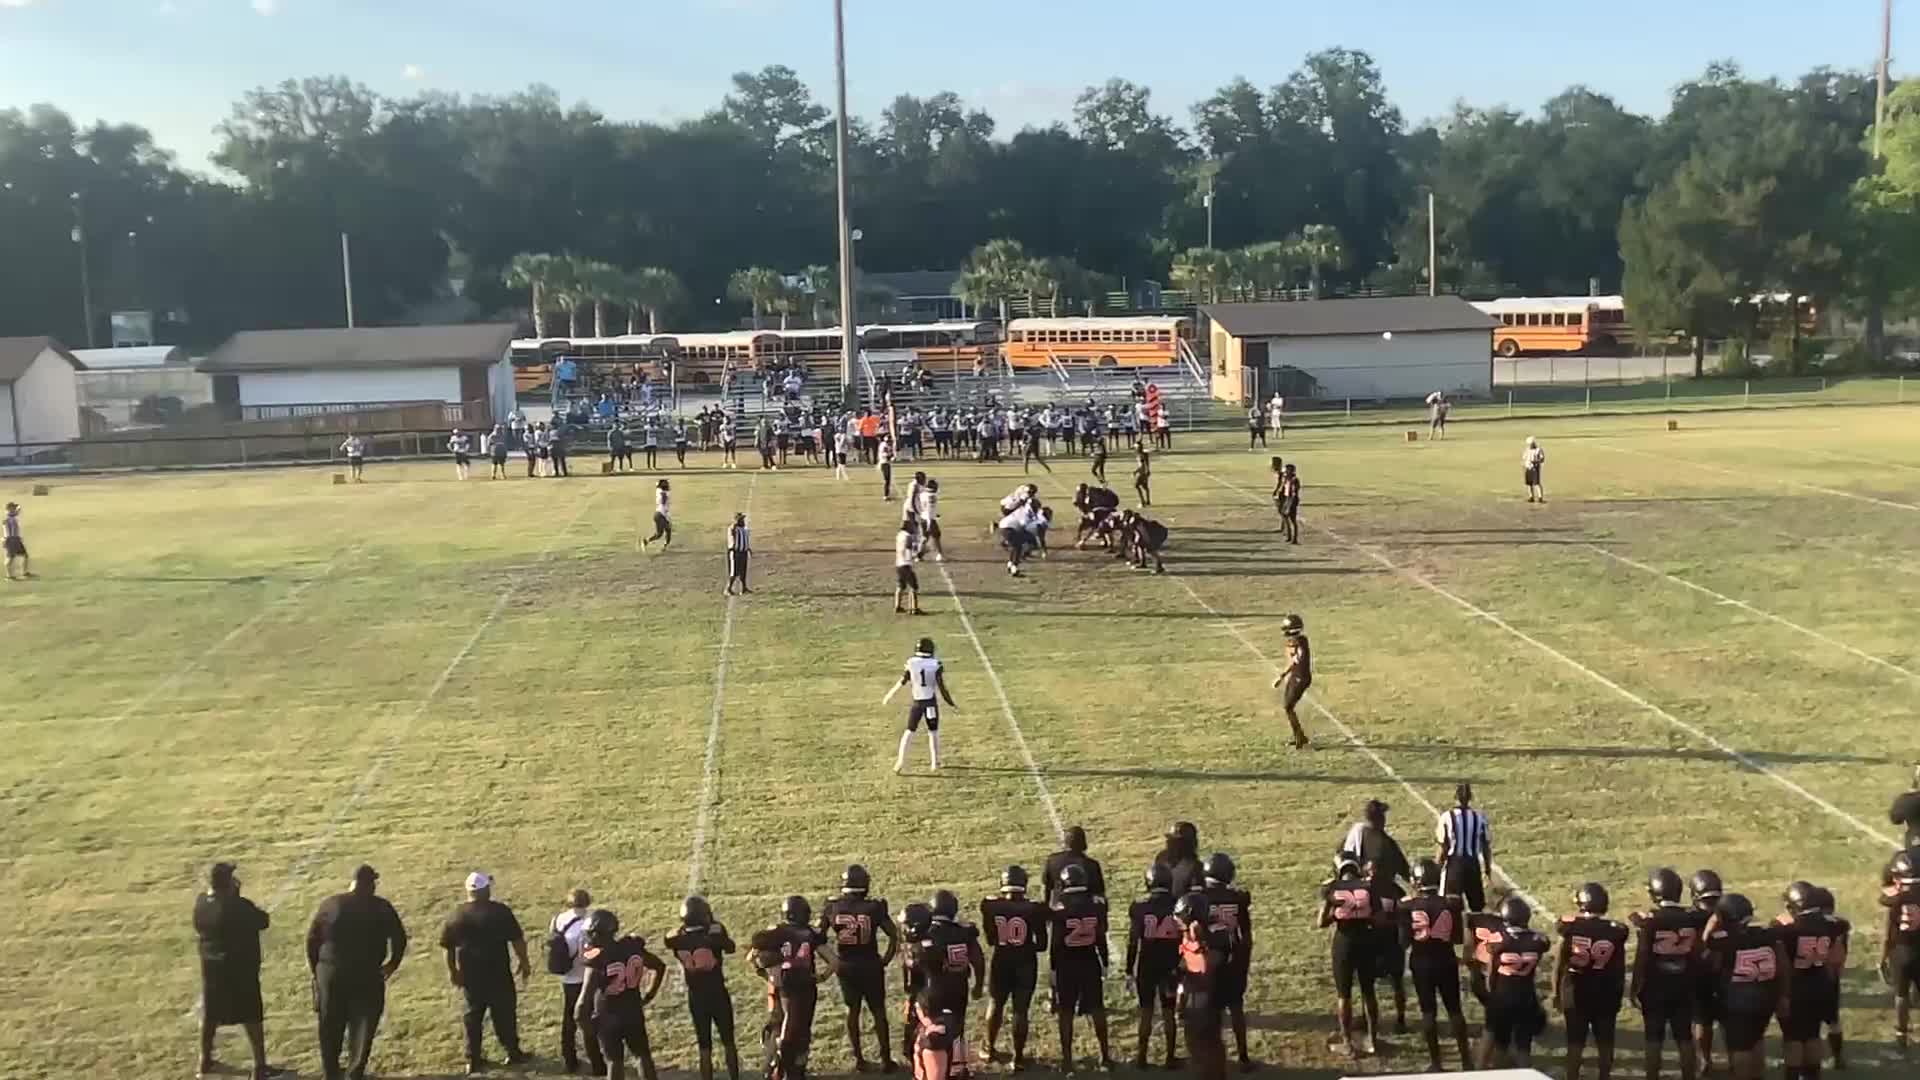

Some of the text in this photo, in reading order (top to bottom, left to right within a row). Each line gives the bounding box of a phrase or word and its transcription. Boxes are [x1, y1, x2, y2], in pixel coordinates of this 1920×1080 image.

[919, 668, 927, 688] 1
[835, 914, 872, 945] 21
[994, 915, 1028, 946] 10
[1063, 917, 1098, 948] 25
